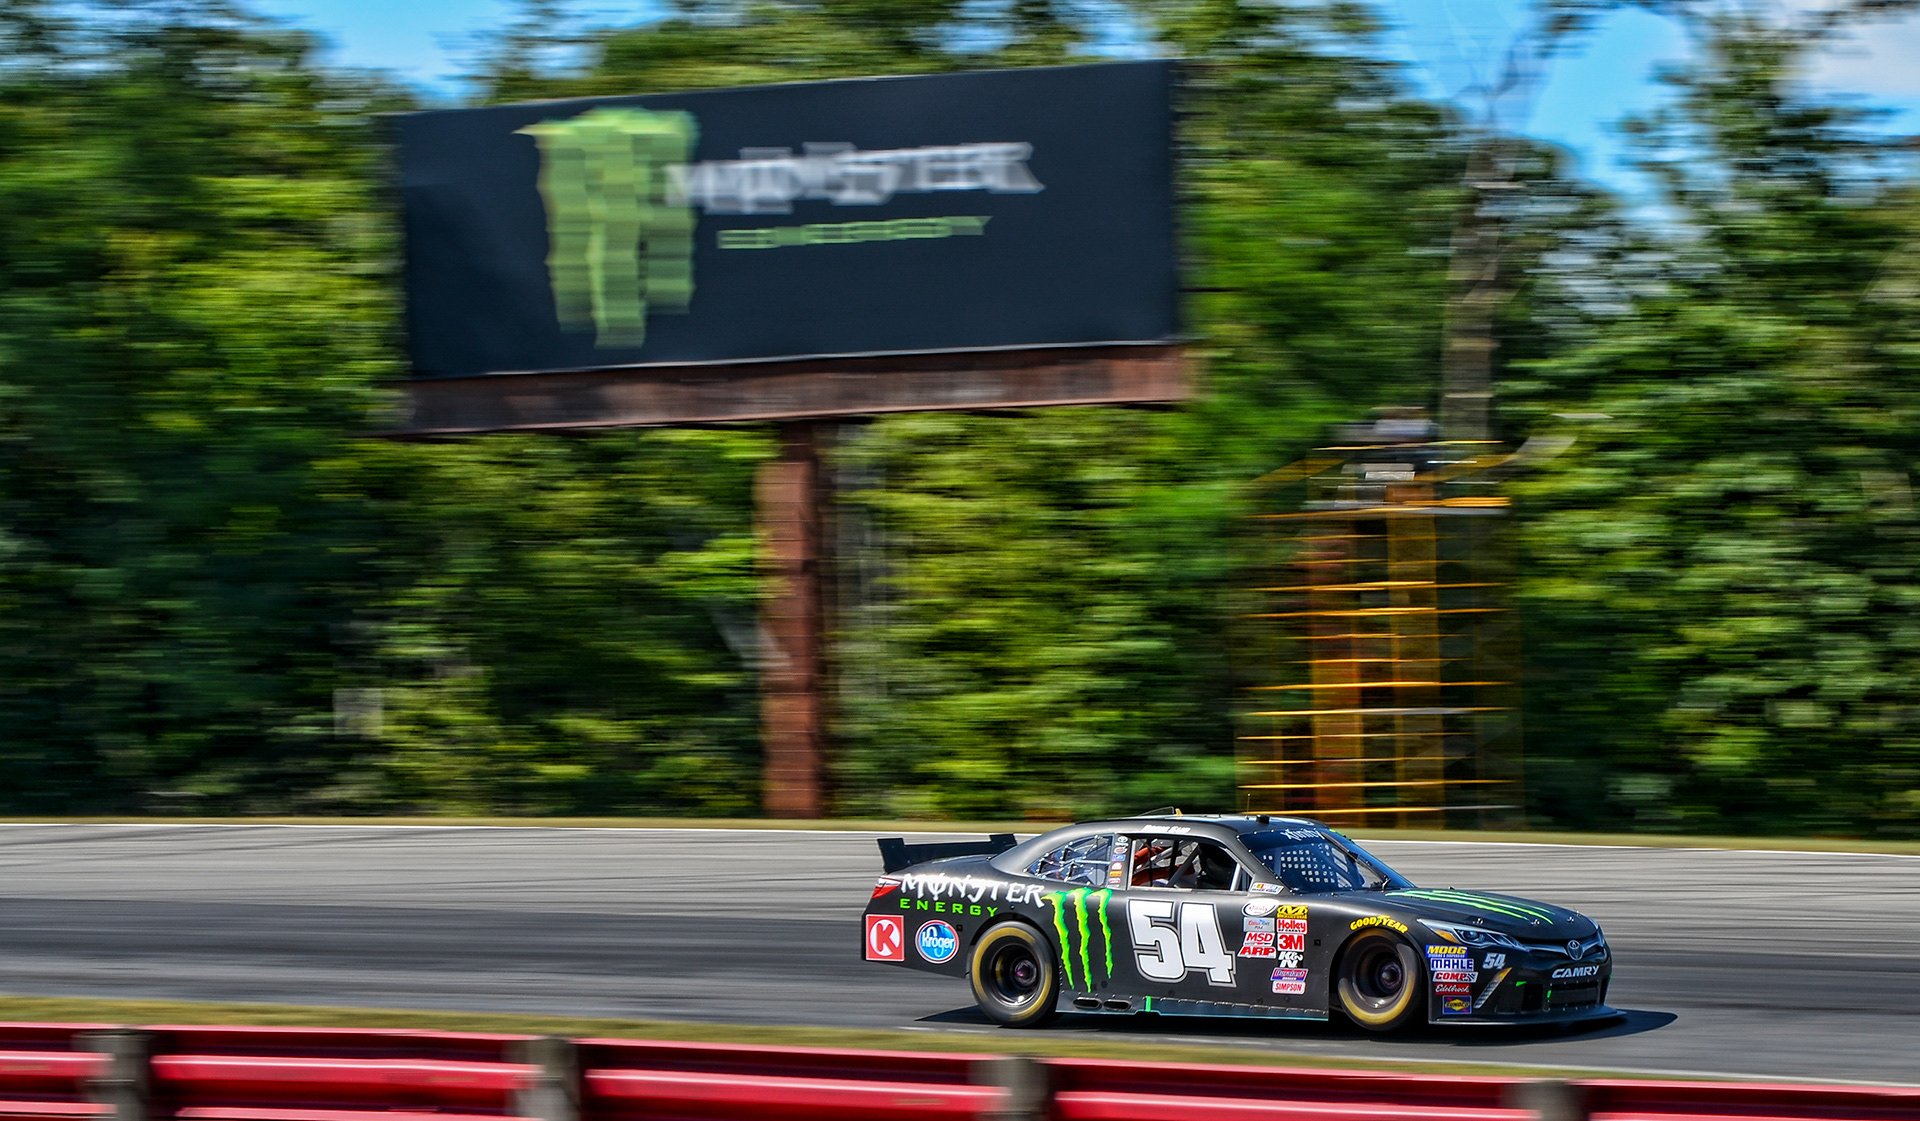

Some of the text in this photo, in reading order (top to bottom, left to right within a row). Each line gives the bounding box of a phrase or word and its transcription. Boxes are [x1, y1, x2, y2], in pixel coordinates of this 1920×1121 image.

[901, 873, 1046, 908] MONSTER
[900, 898, 998, 917] ENERGY
[1278, 919, 1306, 932] Holley
[1350, 914, 1409, 934] GOODYEAR
[921, 926, 956, 958] Kroger
[1127, 898, 1236, 987] 54
[1246, 932, 1273, 942] MSD
[1279, 934, 1303, 949] 3M
[1240, 946, 1275, 956] ARP
[1427, 945, 1467, 955] MOOG
[1431, 959, 1473, 970] MAHLE
[1482, 952, 1506, 970] 54
[1435, 972, 1468, 980] COMP
[1551, 965, 1600, 979] CAMRY
[1275, 982, 1303, 992] SIMPSON
[1435, 984, 1470, 993] Edelbrock
